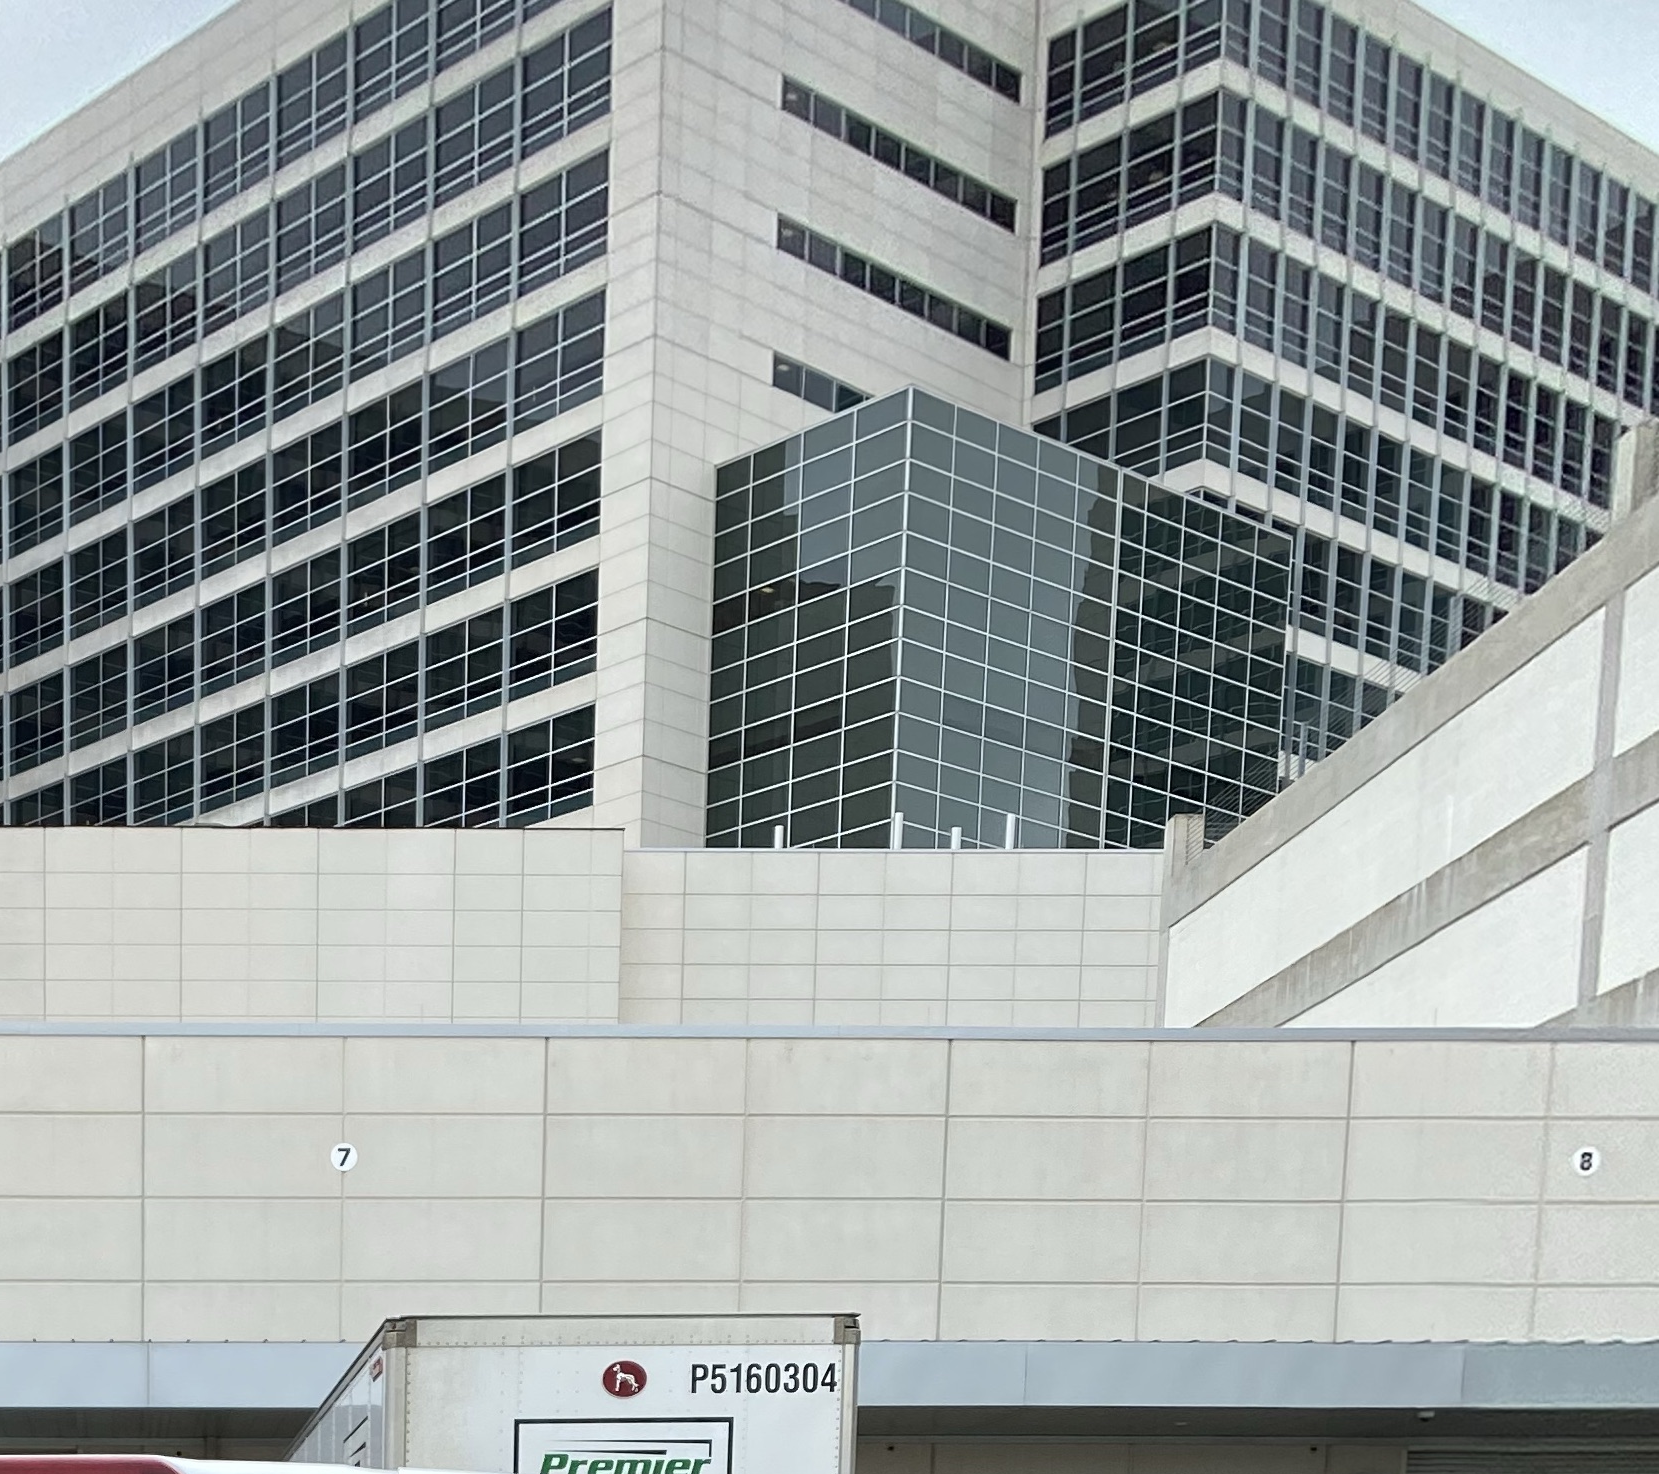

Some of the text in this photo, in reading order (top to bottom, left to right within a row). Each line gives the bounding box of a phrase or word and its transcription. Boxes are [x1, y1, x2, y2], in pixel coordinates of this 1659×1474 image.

[338, 1148, 350, 1166] 7
[1581, 1152, 1593, 1170] 8
[691, 1363, 838, 1394] P5160304
